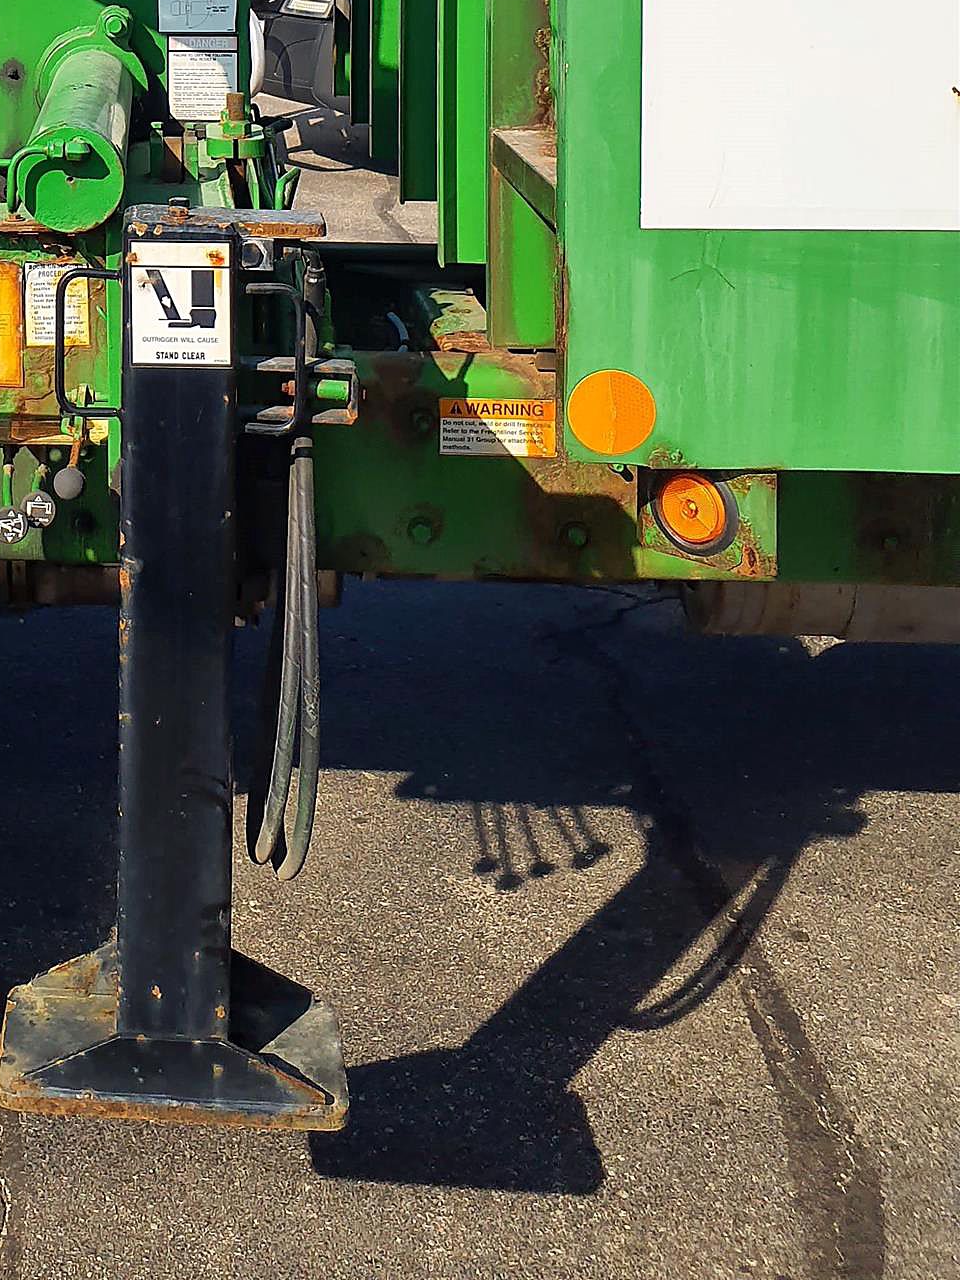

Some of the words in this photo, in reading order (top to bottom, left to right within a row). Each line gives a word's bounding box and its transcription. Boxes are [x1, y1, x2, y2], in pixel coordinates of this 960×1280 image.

[189, 39, 229, 48] DANGER
[155, 351, 179, 360] STAND
[182, 352, 206, 360] CLEAR
[464, 402, 544, 417] WARNING
